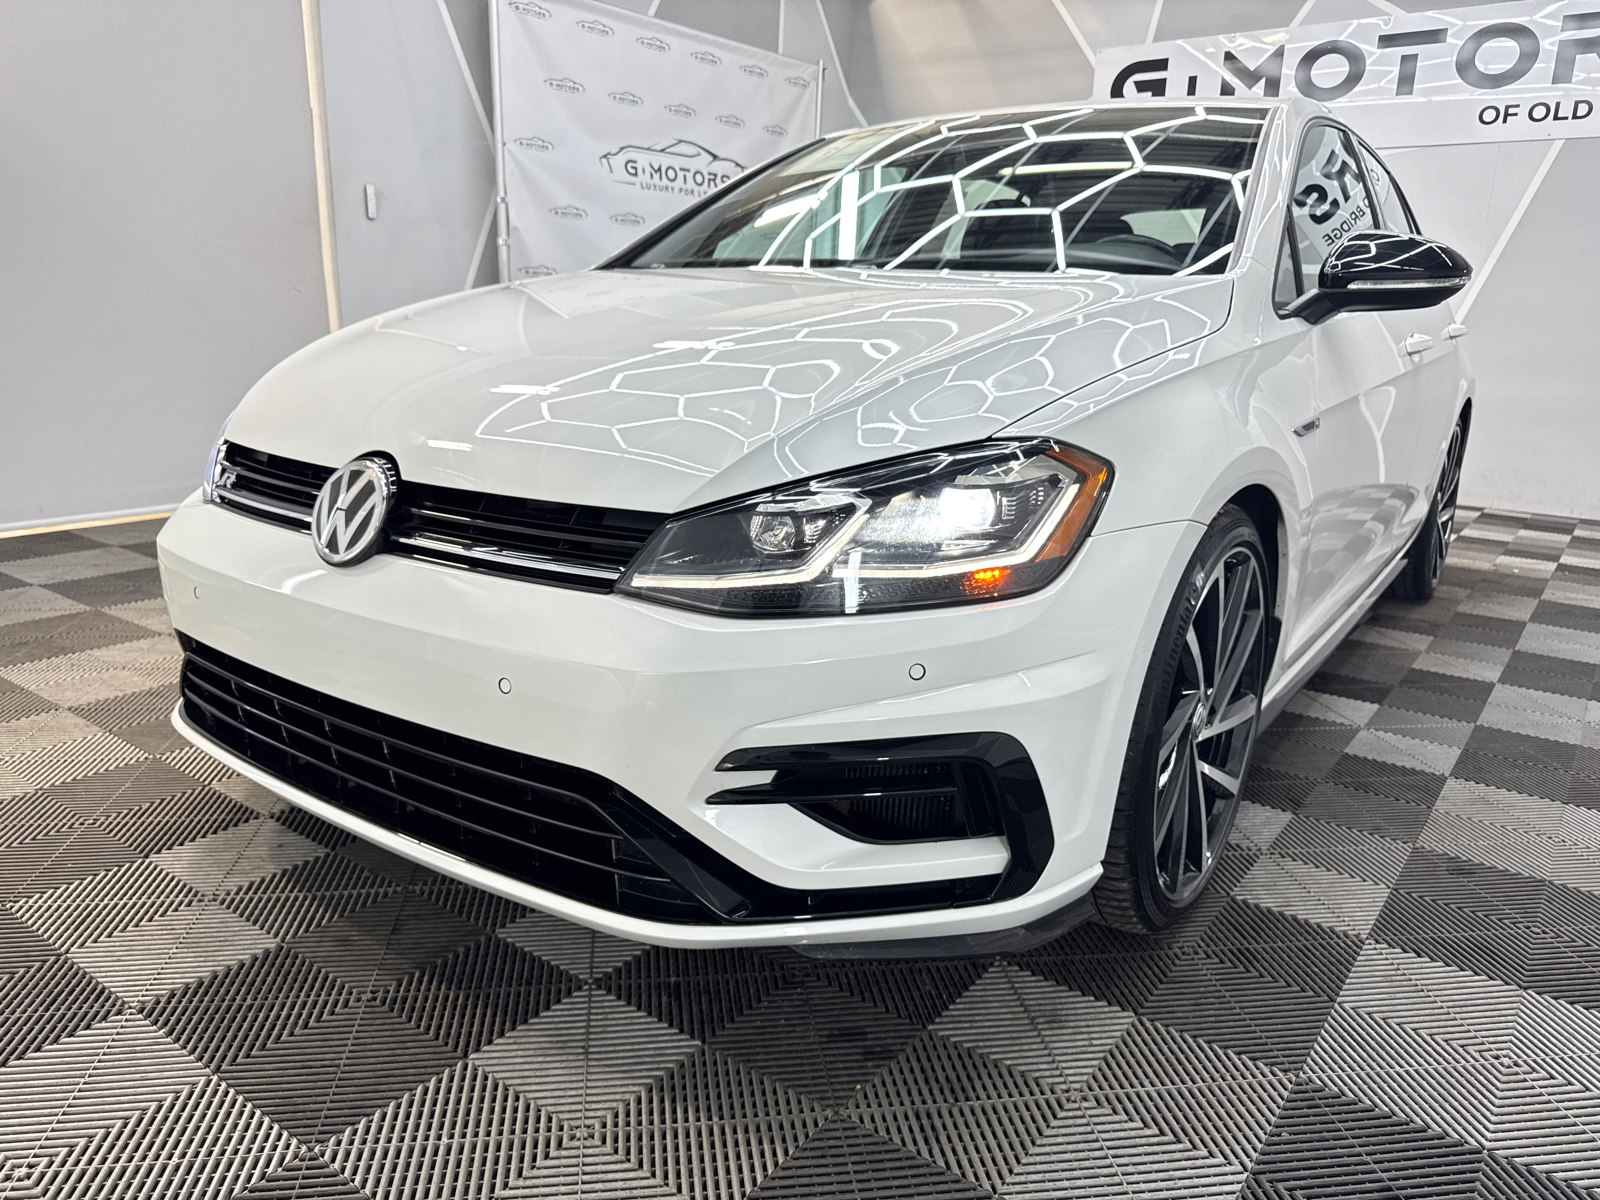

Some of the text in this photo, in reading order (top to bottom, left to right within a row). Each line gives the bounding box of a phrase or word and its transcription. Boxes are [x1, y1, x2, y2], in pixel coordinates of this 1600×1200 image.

[1478, 99, 1594, 126] OF OLD
[640, 181, 676, 194] LUXURY
[678, 188, 695, 197] FOR
